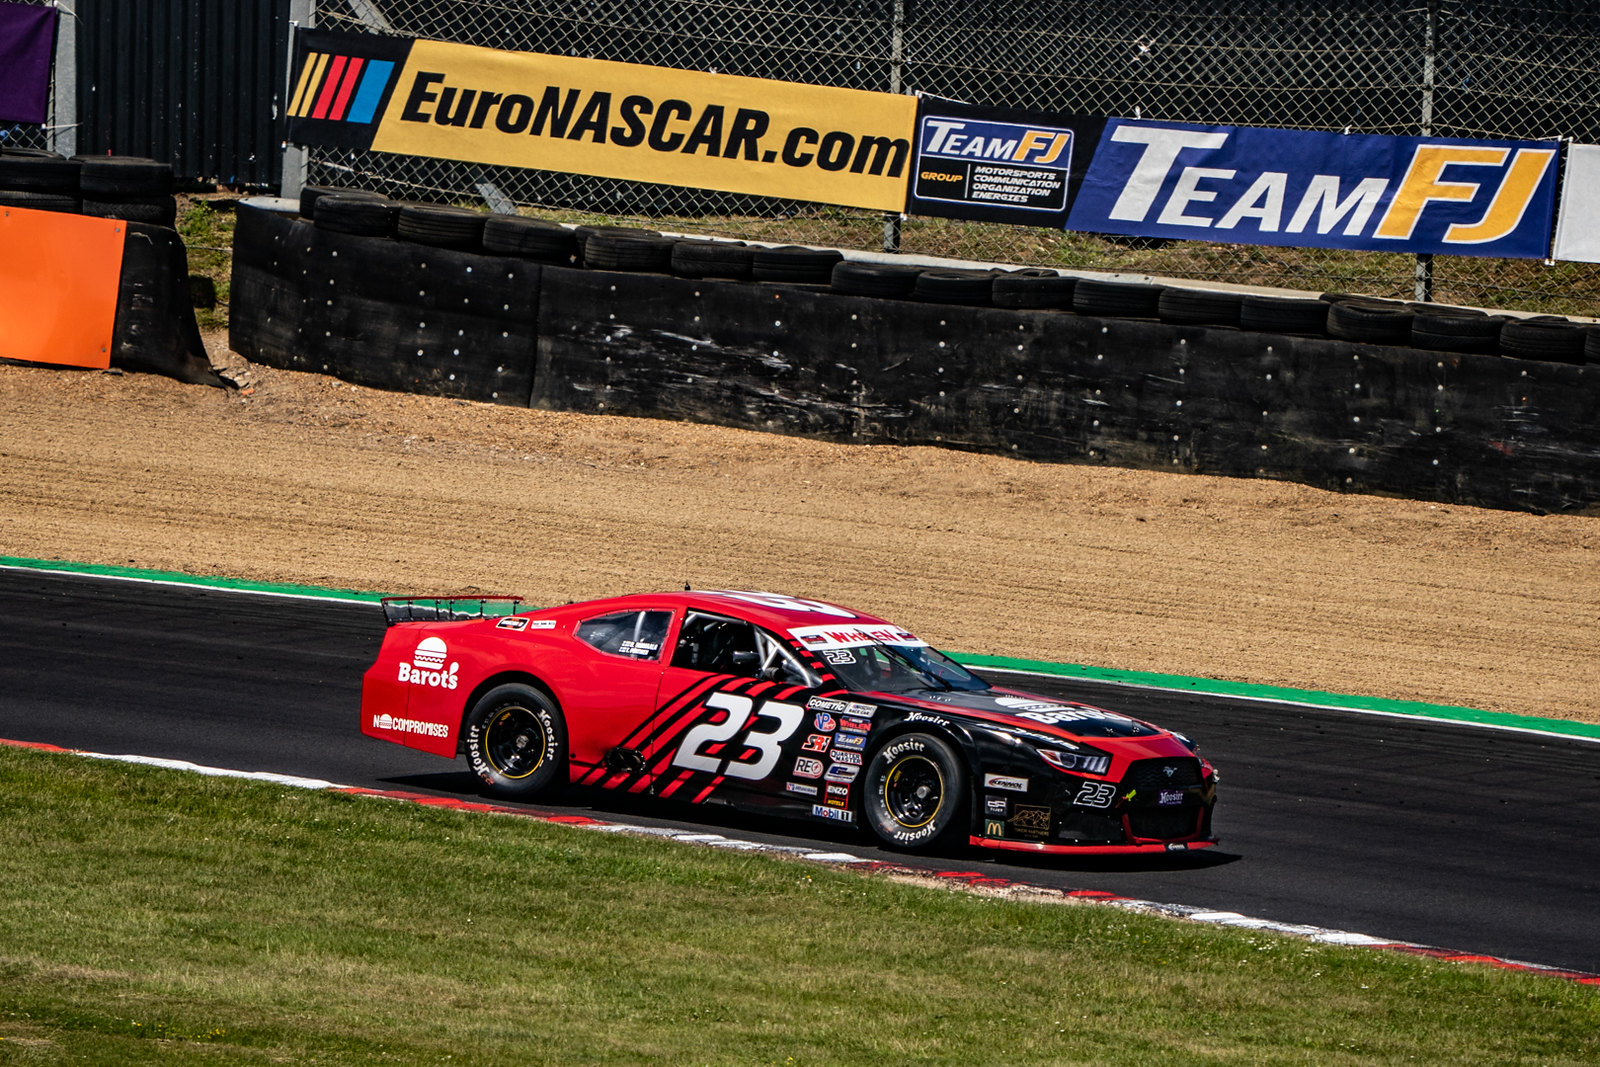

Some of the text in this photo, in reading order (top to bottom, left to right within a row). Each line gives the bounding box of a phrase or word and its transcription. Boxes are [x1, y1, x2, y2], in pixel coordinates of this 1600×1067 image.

[400, 71, 910, 178] EuroNASCAR.com
[920, 171, 964, 183] GROUP
[973, 174, 1062, 189] COMMUNICATION
[974, 166, 1057, 180] MOTORSPORTS
[971, 191, 1029, 203] ENERGIES
[972, 182, 1052, 197] ORGANIZATION
[822, 649, 857, 665] 23
[397, 661, 460, 690] Barot's
[809, 699, 845, 712] COMETIC
[392, 717, 449, 738] COMPROMISES
[903, 711, 950, 726] Hoosier
[537, 708, 559, 761] Hoosier
[672, 691, 805, 781] 23
[467, 725, 490, 776] Hoosier
[882, 738, 925, 764] Hoosier
[1073, 781, 1117, 808] 23
[815, 806, 840, 819] Mobil
[893, 819, 936, 845] Hoosier
